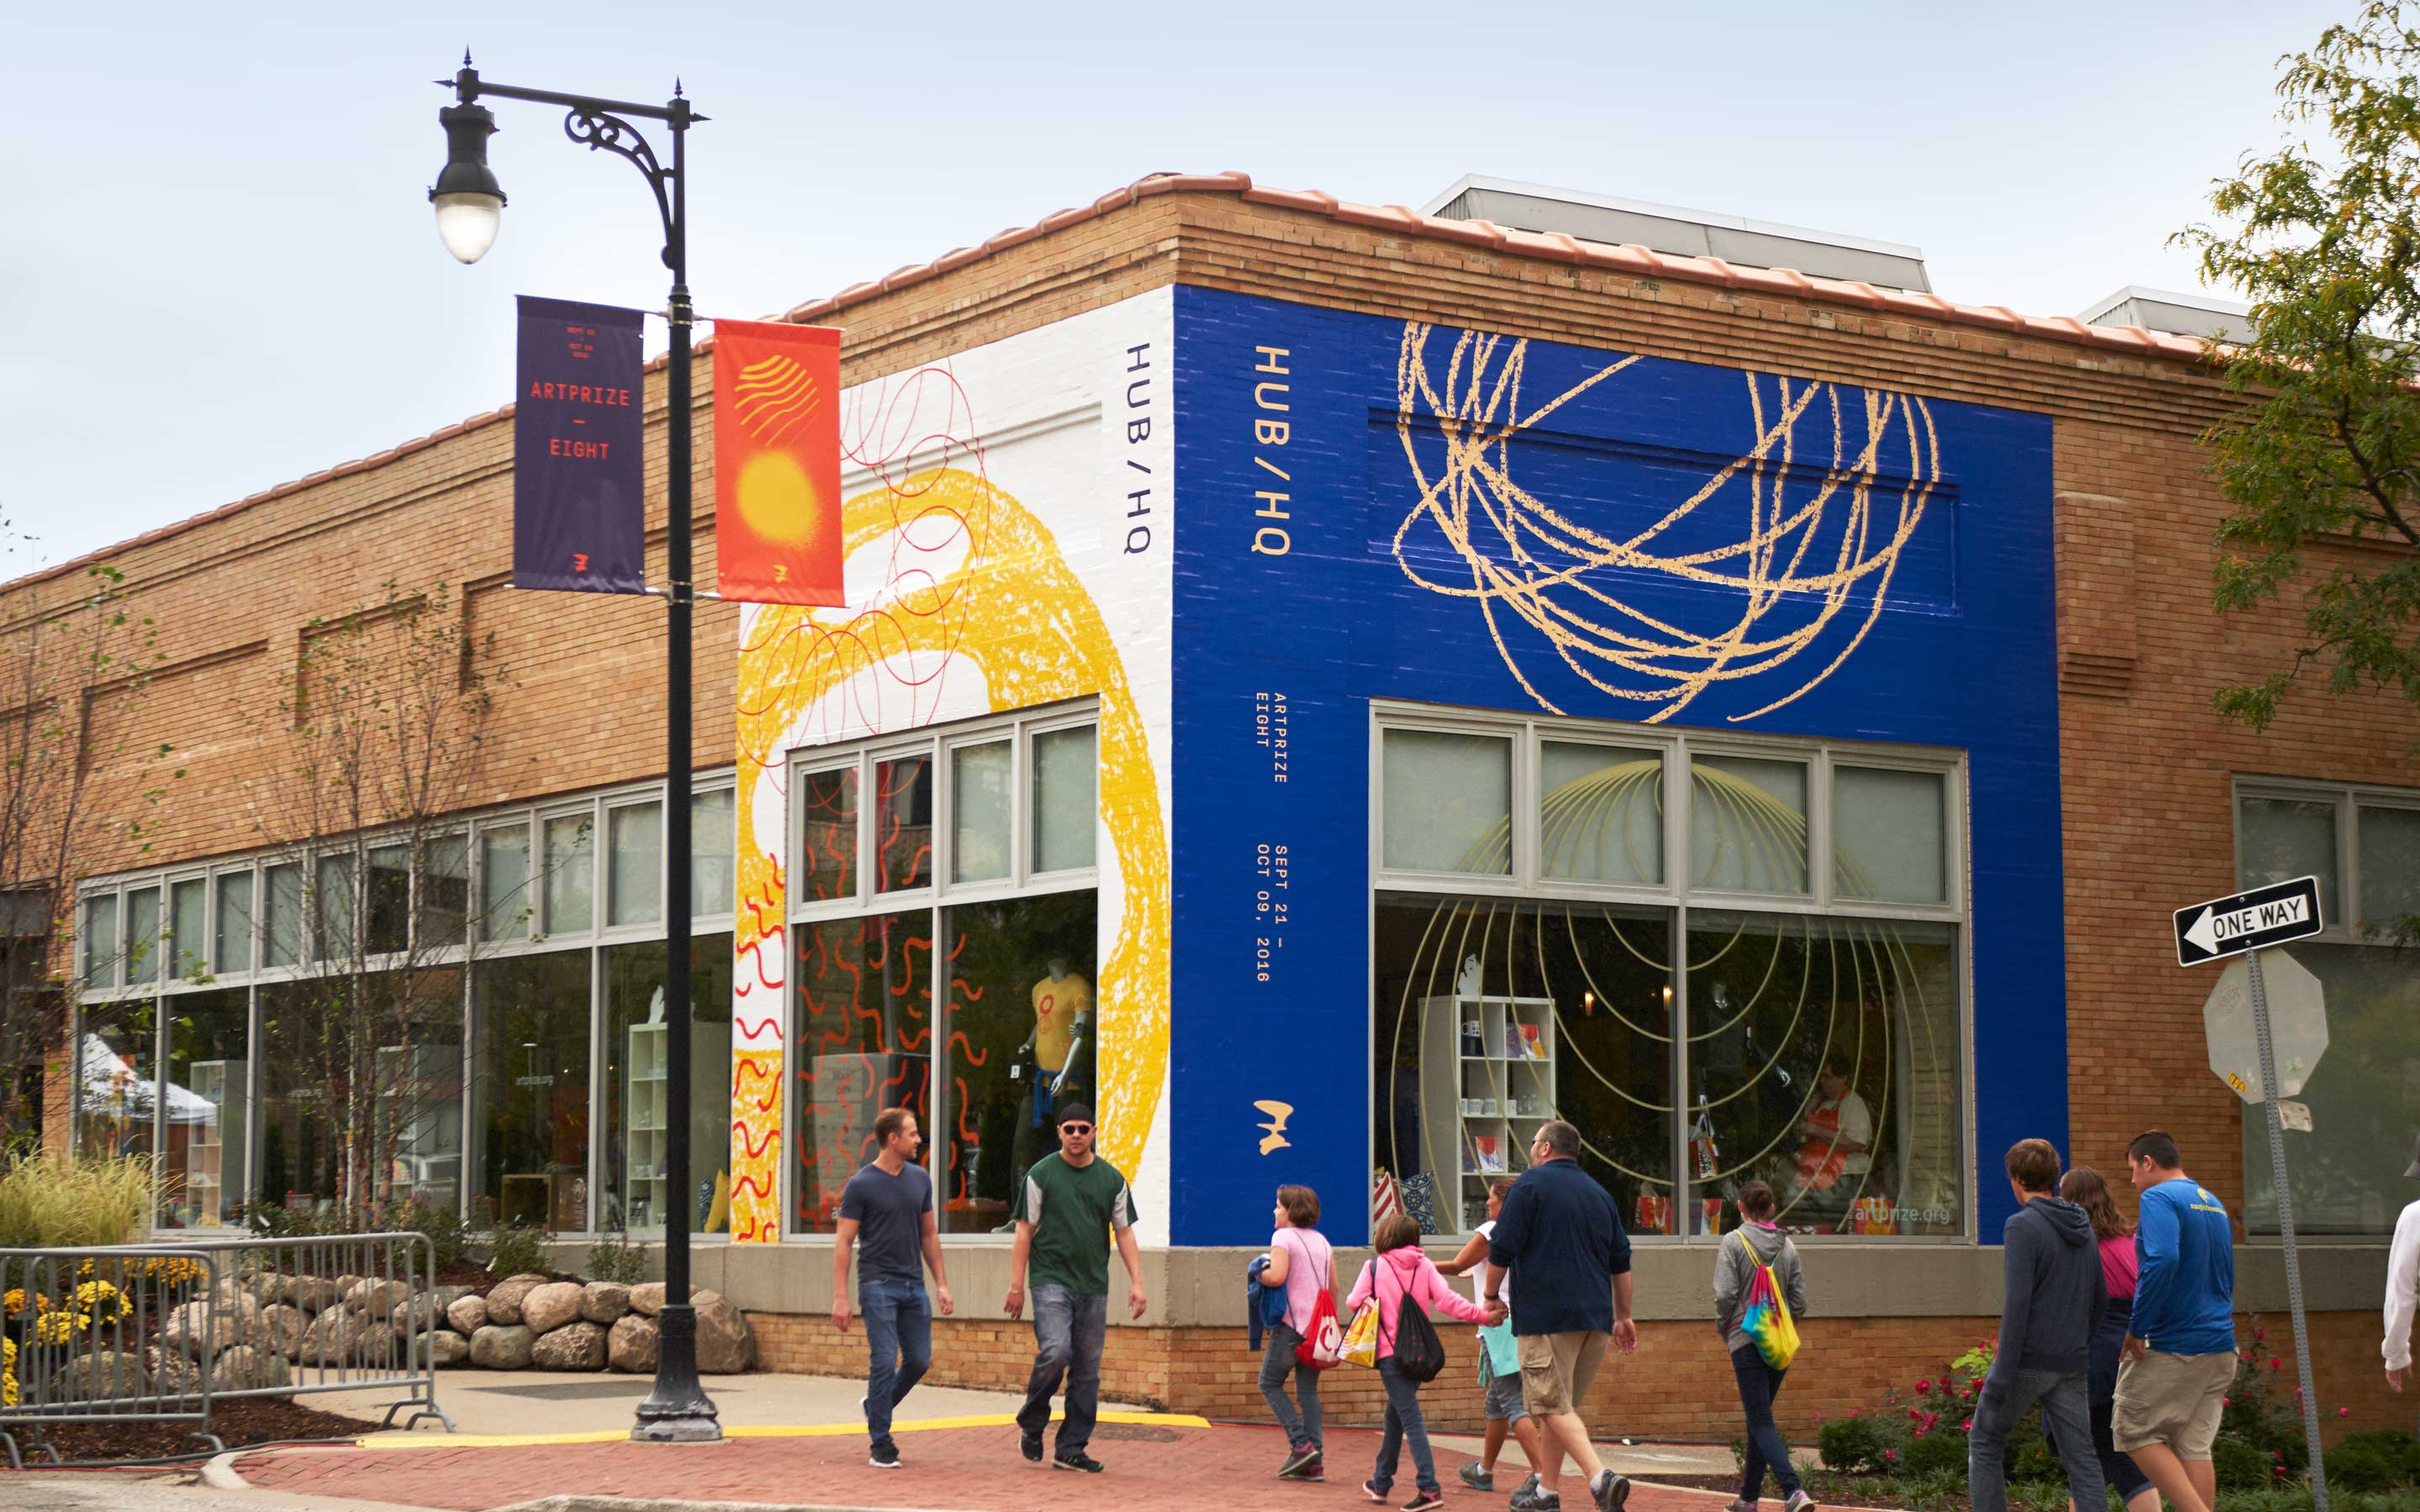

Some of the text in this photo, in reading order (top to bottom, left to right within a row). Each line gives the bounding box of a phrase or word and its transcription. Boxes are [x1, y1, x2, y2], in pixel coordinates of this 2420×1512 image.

[530, 381, 629, 407] ARTPRIZE
[550, 438, 610, 459] EIGHT
[1123, 343, 1151, 555] HUB/HQ
[1251, 345, 1291, 556] HUB/HQ
[1256, 692, 1269, 747] EIGHT
[1274, 692, 1287, 783] ARTPRIZE
[1275, 845, 1288, 890] SEPT
[1255, 844, 1270, 982] OCT 09, 2016
[1275, 903, 1288, 924] 21
[2213, 898, 2301, 939] ONE WAY
